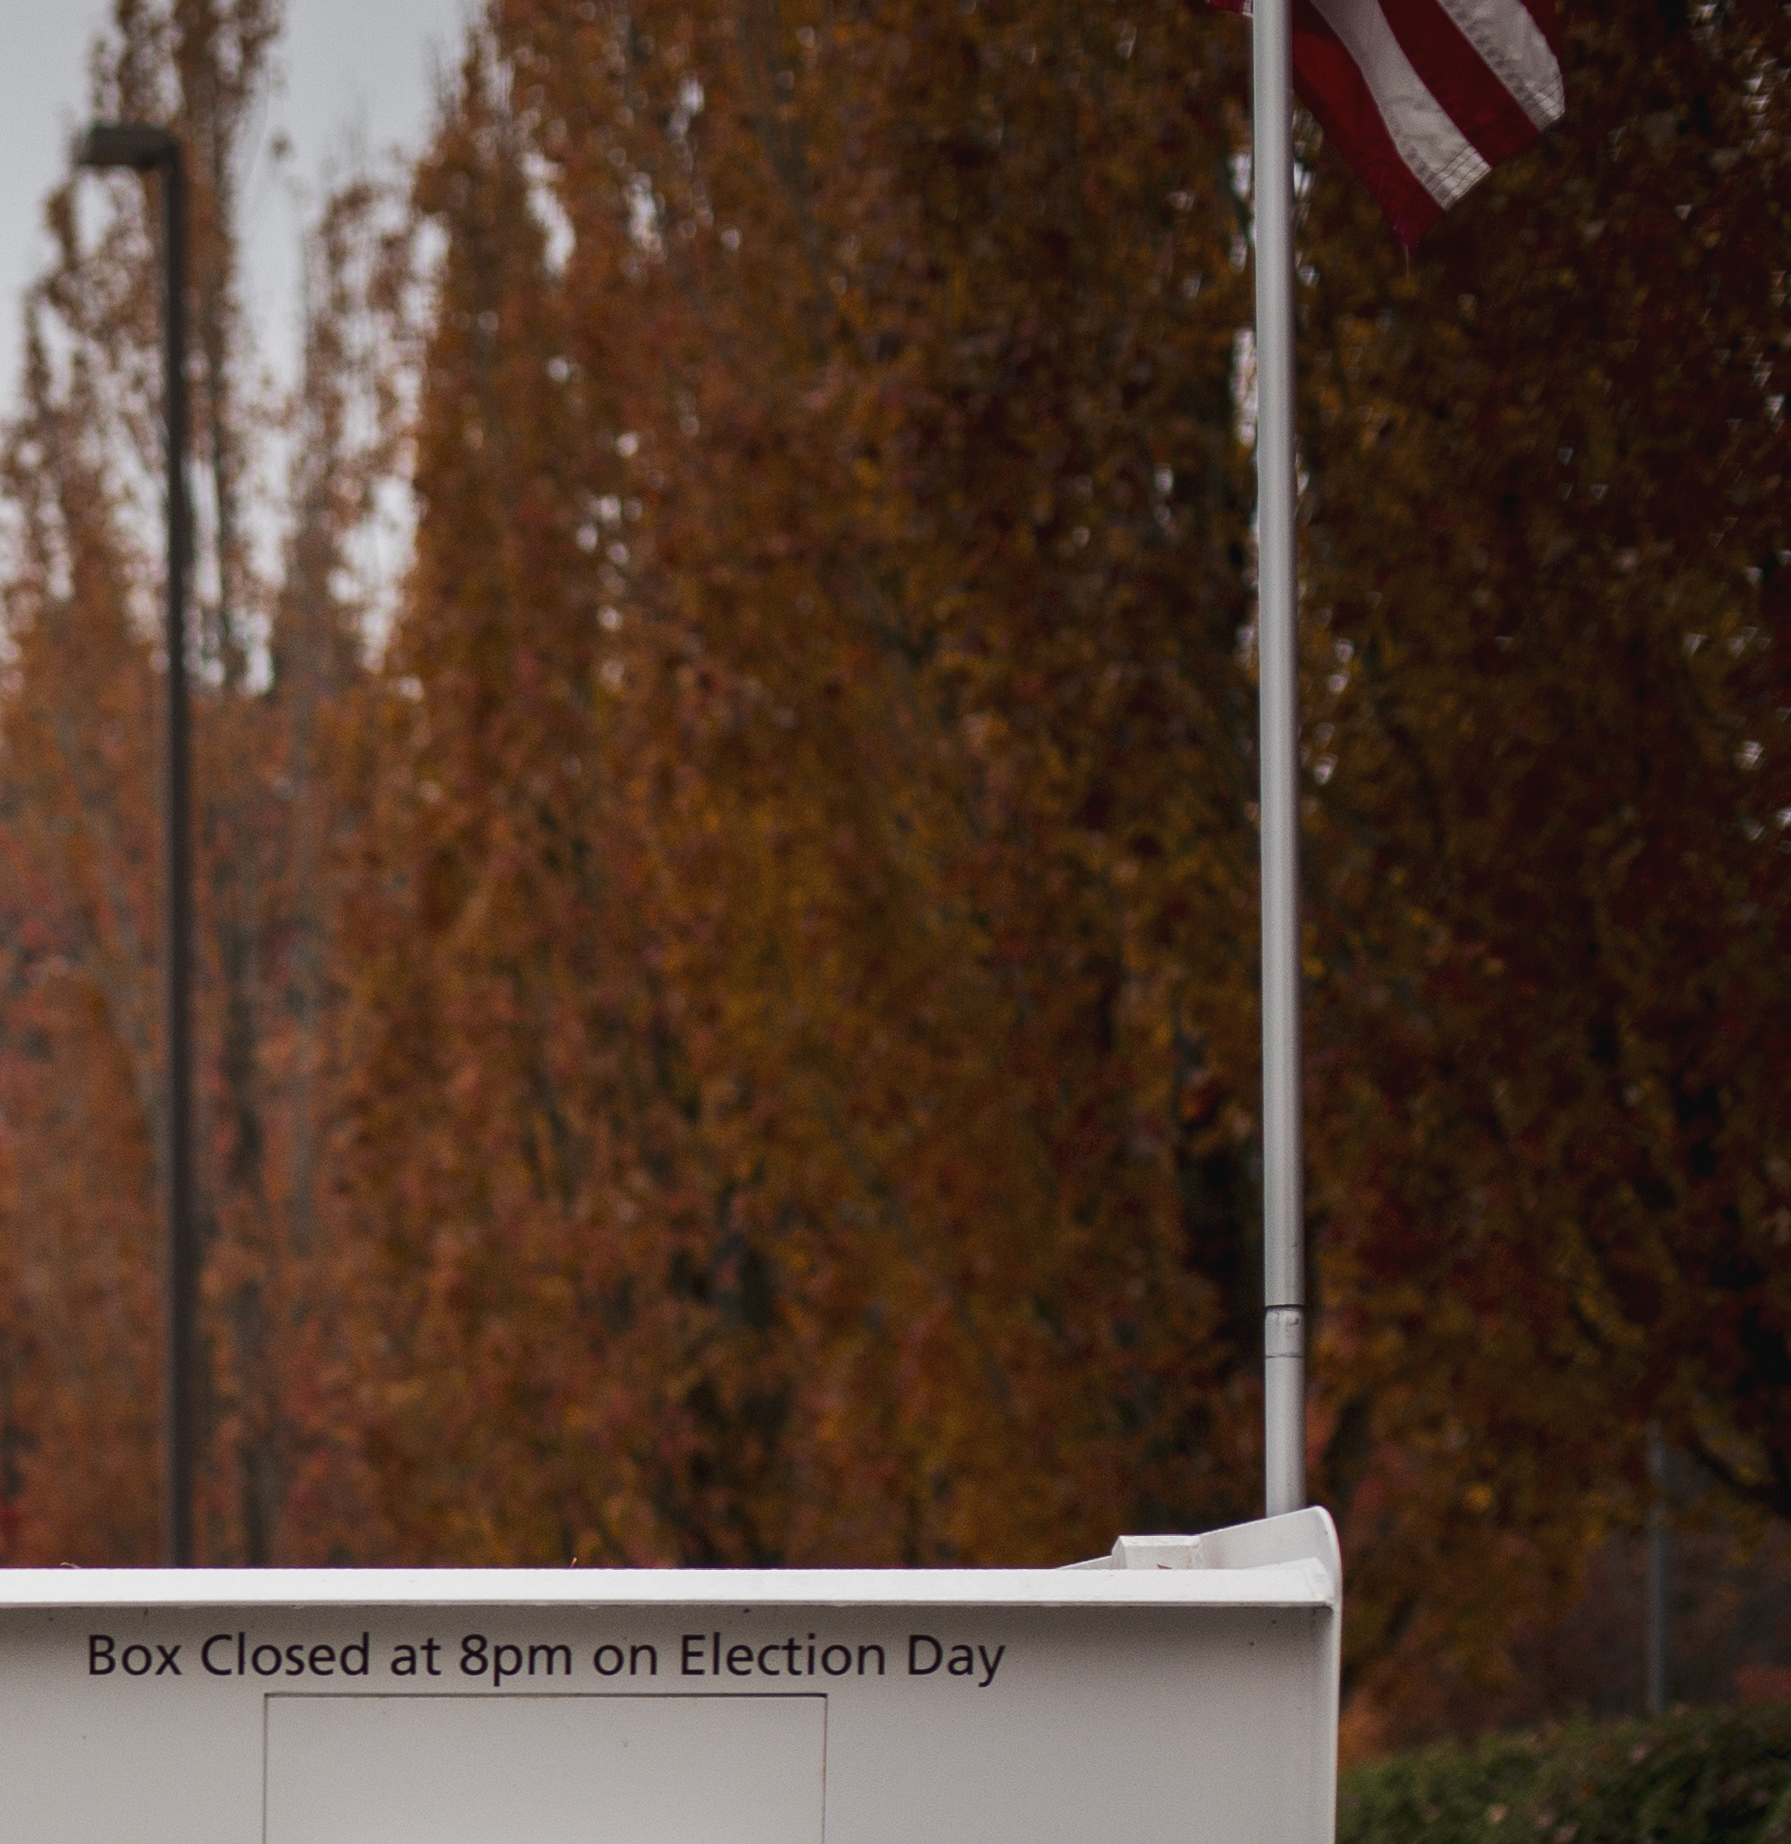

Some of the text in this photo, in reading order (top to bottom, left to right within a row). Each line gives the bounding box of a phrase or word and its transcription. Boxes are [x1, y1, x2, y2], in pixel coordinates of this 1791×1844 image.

[88, 1631, 1007, 1688] Box Closed at 8pm on Election Day
